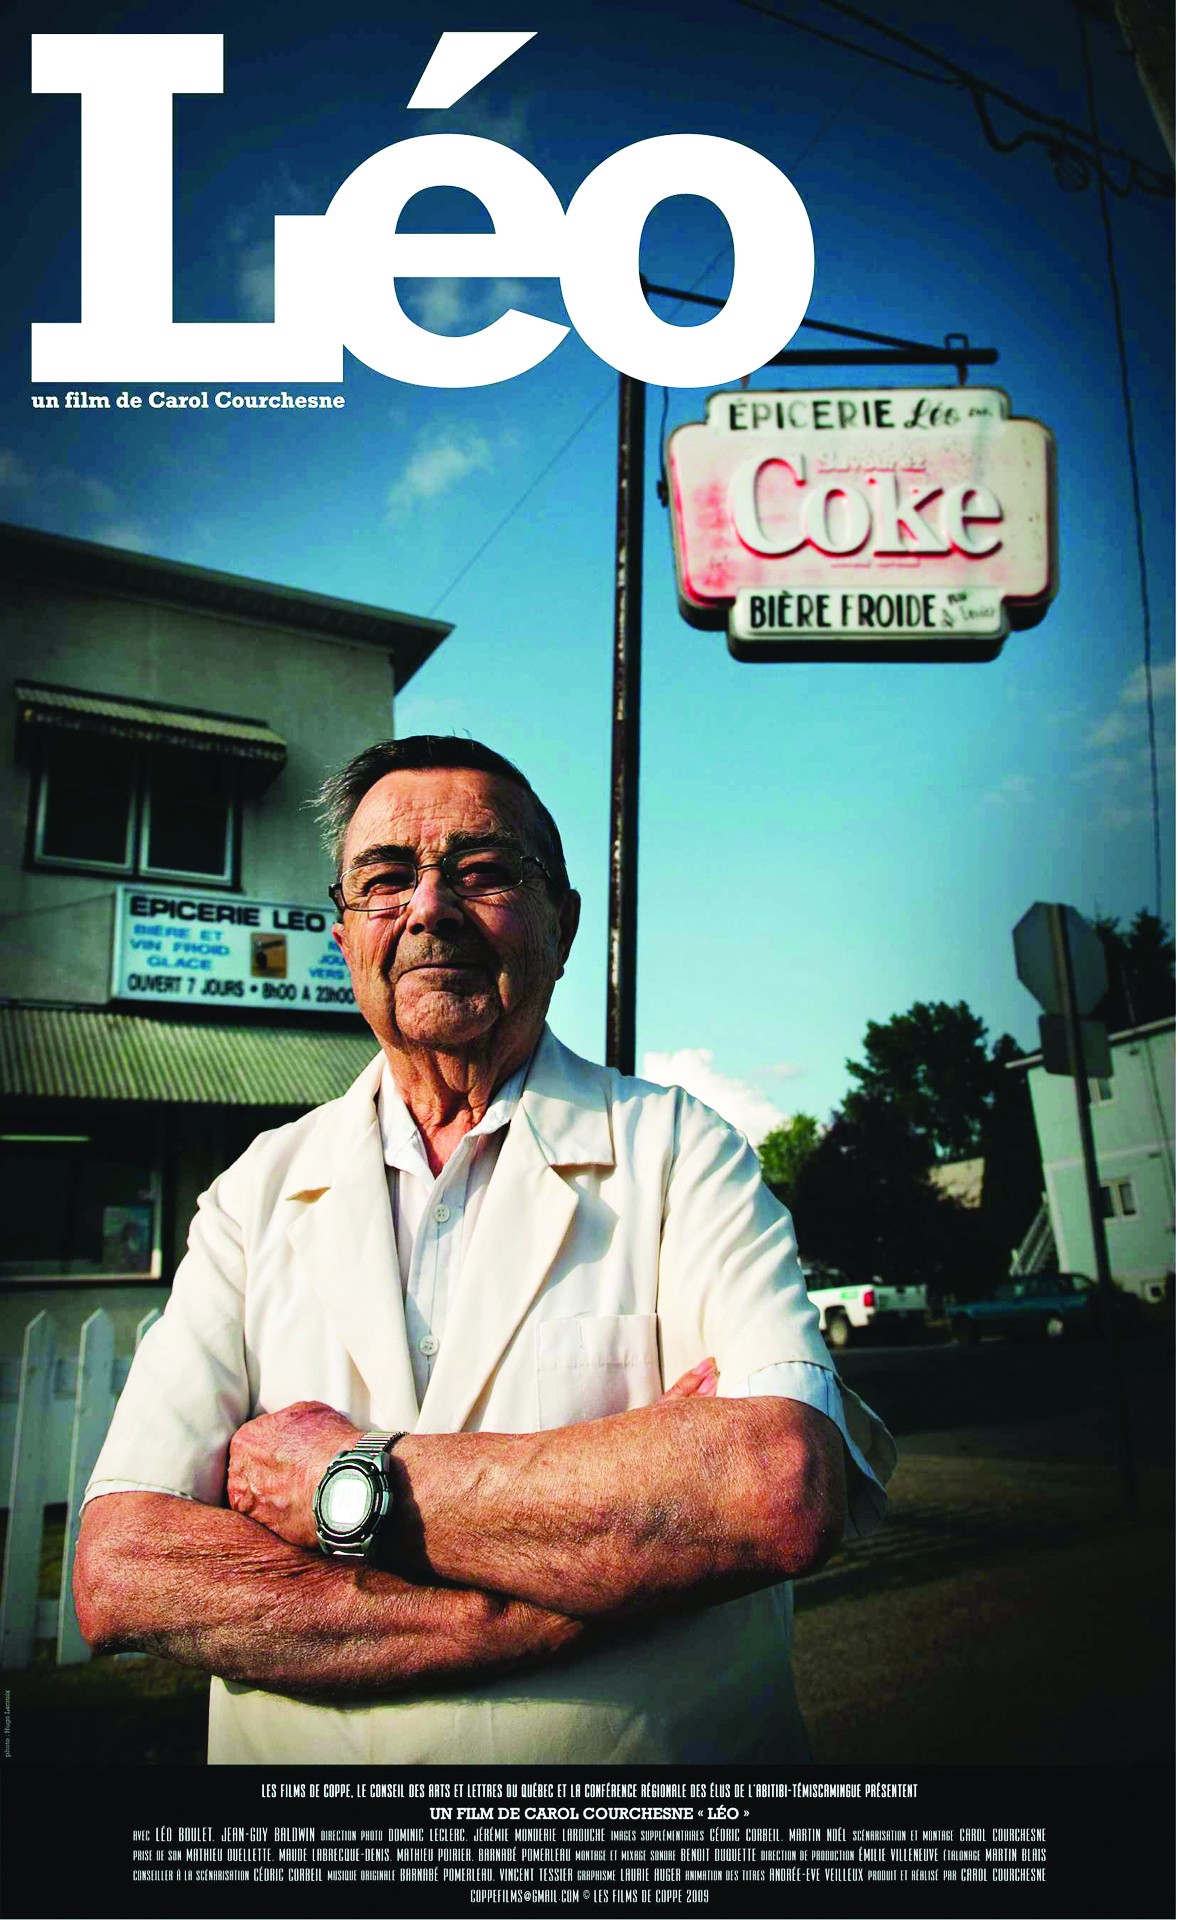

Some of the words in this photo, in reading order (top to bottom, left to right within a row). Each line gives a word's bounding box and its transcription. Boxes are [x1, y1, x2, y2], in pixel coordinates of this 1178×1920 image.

[728, 396, 896, 431] ÉPICERIE
[903, 397, 961, 429] Léo
[728, 455, 1004, 560] Coke
[749, 590, 832, 629] BIÈRE
[841, 593, 936, 629] FROIDE
[130, 895, 260, 927] EPICERIE
[273, 909, 326, 933] LEO
[128, 938, 162, 953] VIN
[172, 941, 232, 957] FROID
[199, 929, 225, 942] ET
[146, 954, 213, 971] GLACE
[127, 972, 183, 993] OUVERT
[186, 977, 197, 995] 7
[201, 978, 245, 998] JOURS
